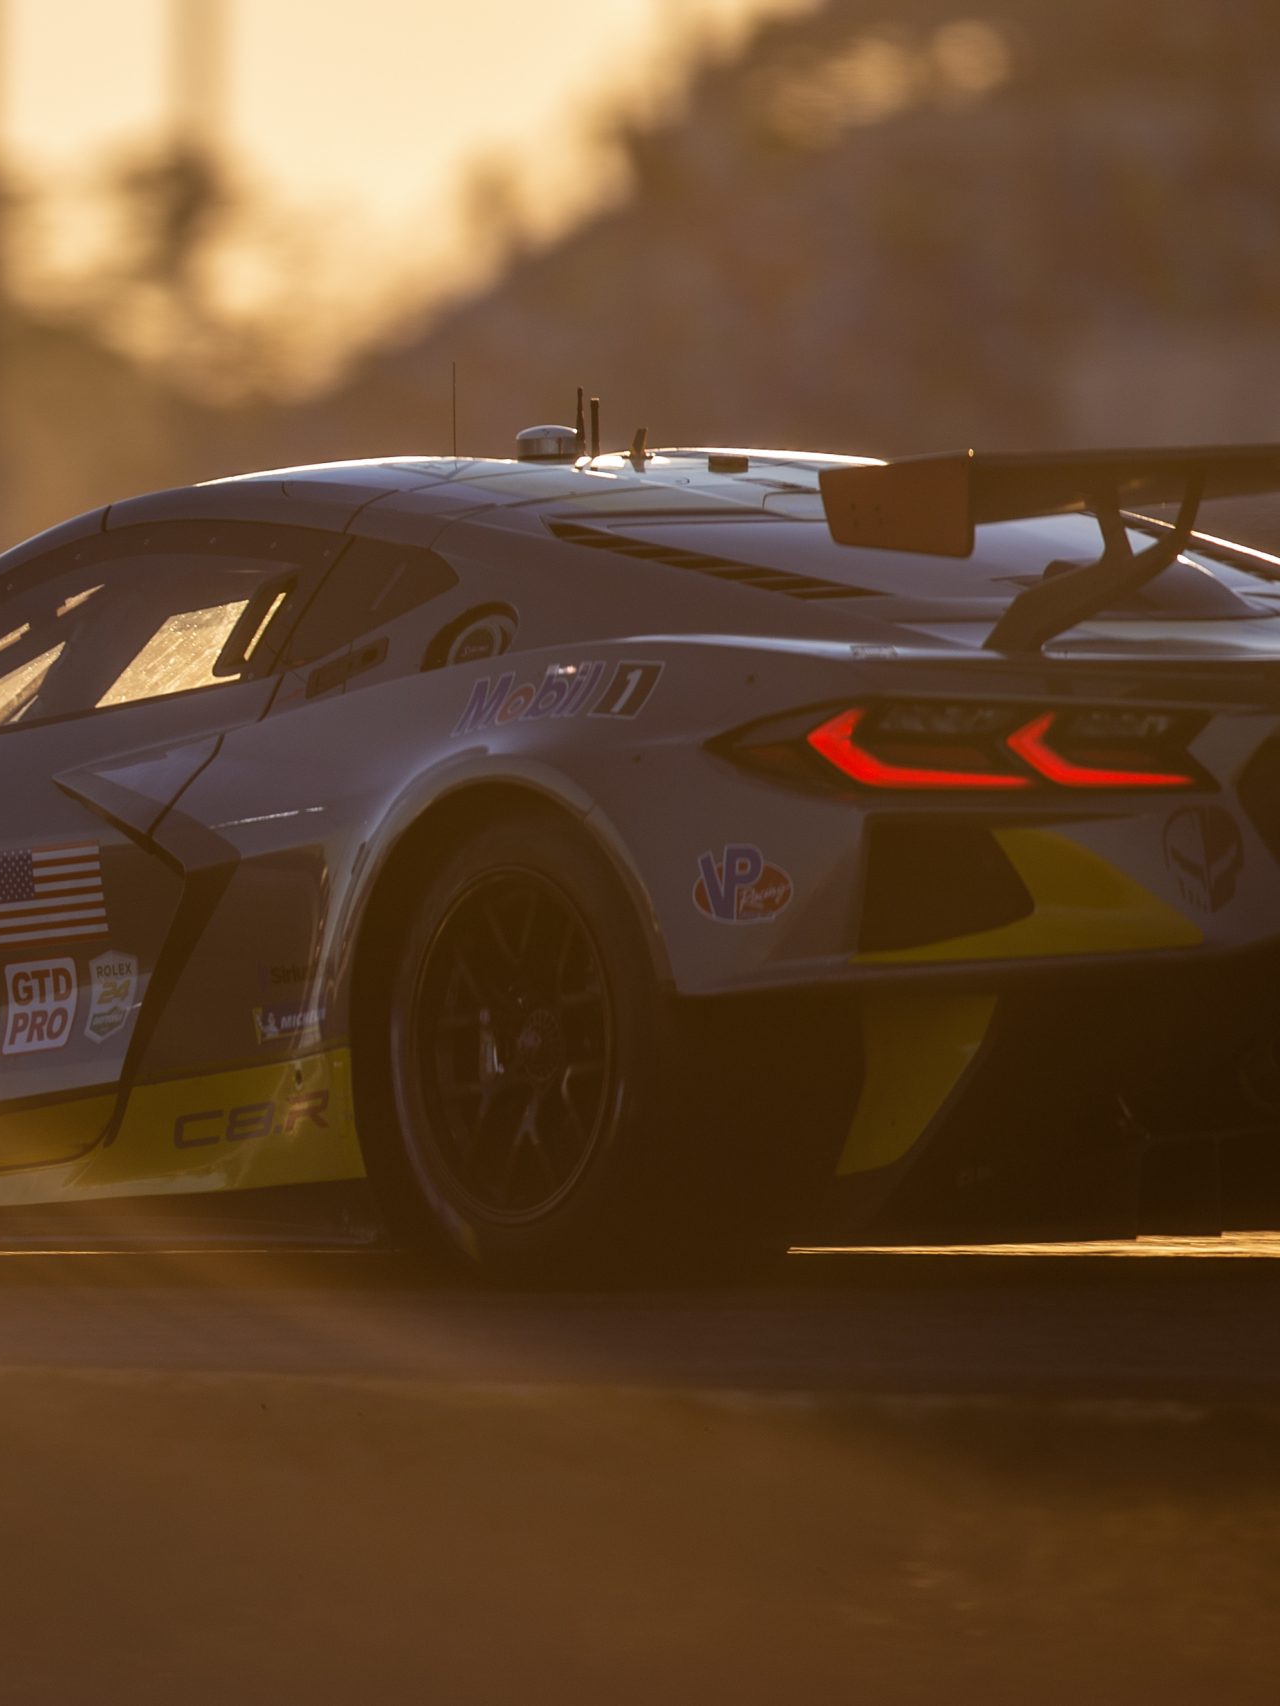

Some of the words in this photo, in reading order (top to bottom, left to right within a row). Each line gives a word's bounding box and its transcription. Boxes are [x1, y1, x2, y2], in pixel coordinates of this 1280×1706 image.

[450, 661, 606, 737] Mobil
[698, 843, 764, 921] VP
[11, 964, 73, 1006] GTD
[95, 962, 133, 979] ROLEX
[96, 979, 131, 1005] 24
[9, 1006, 69, 1046] PRO
